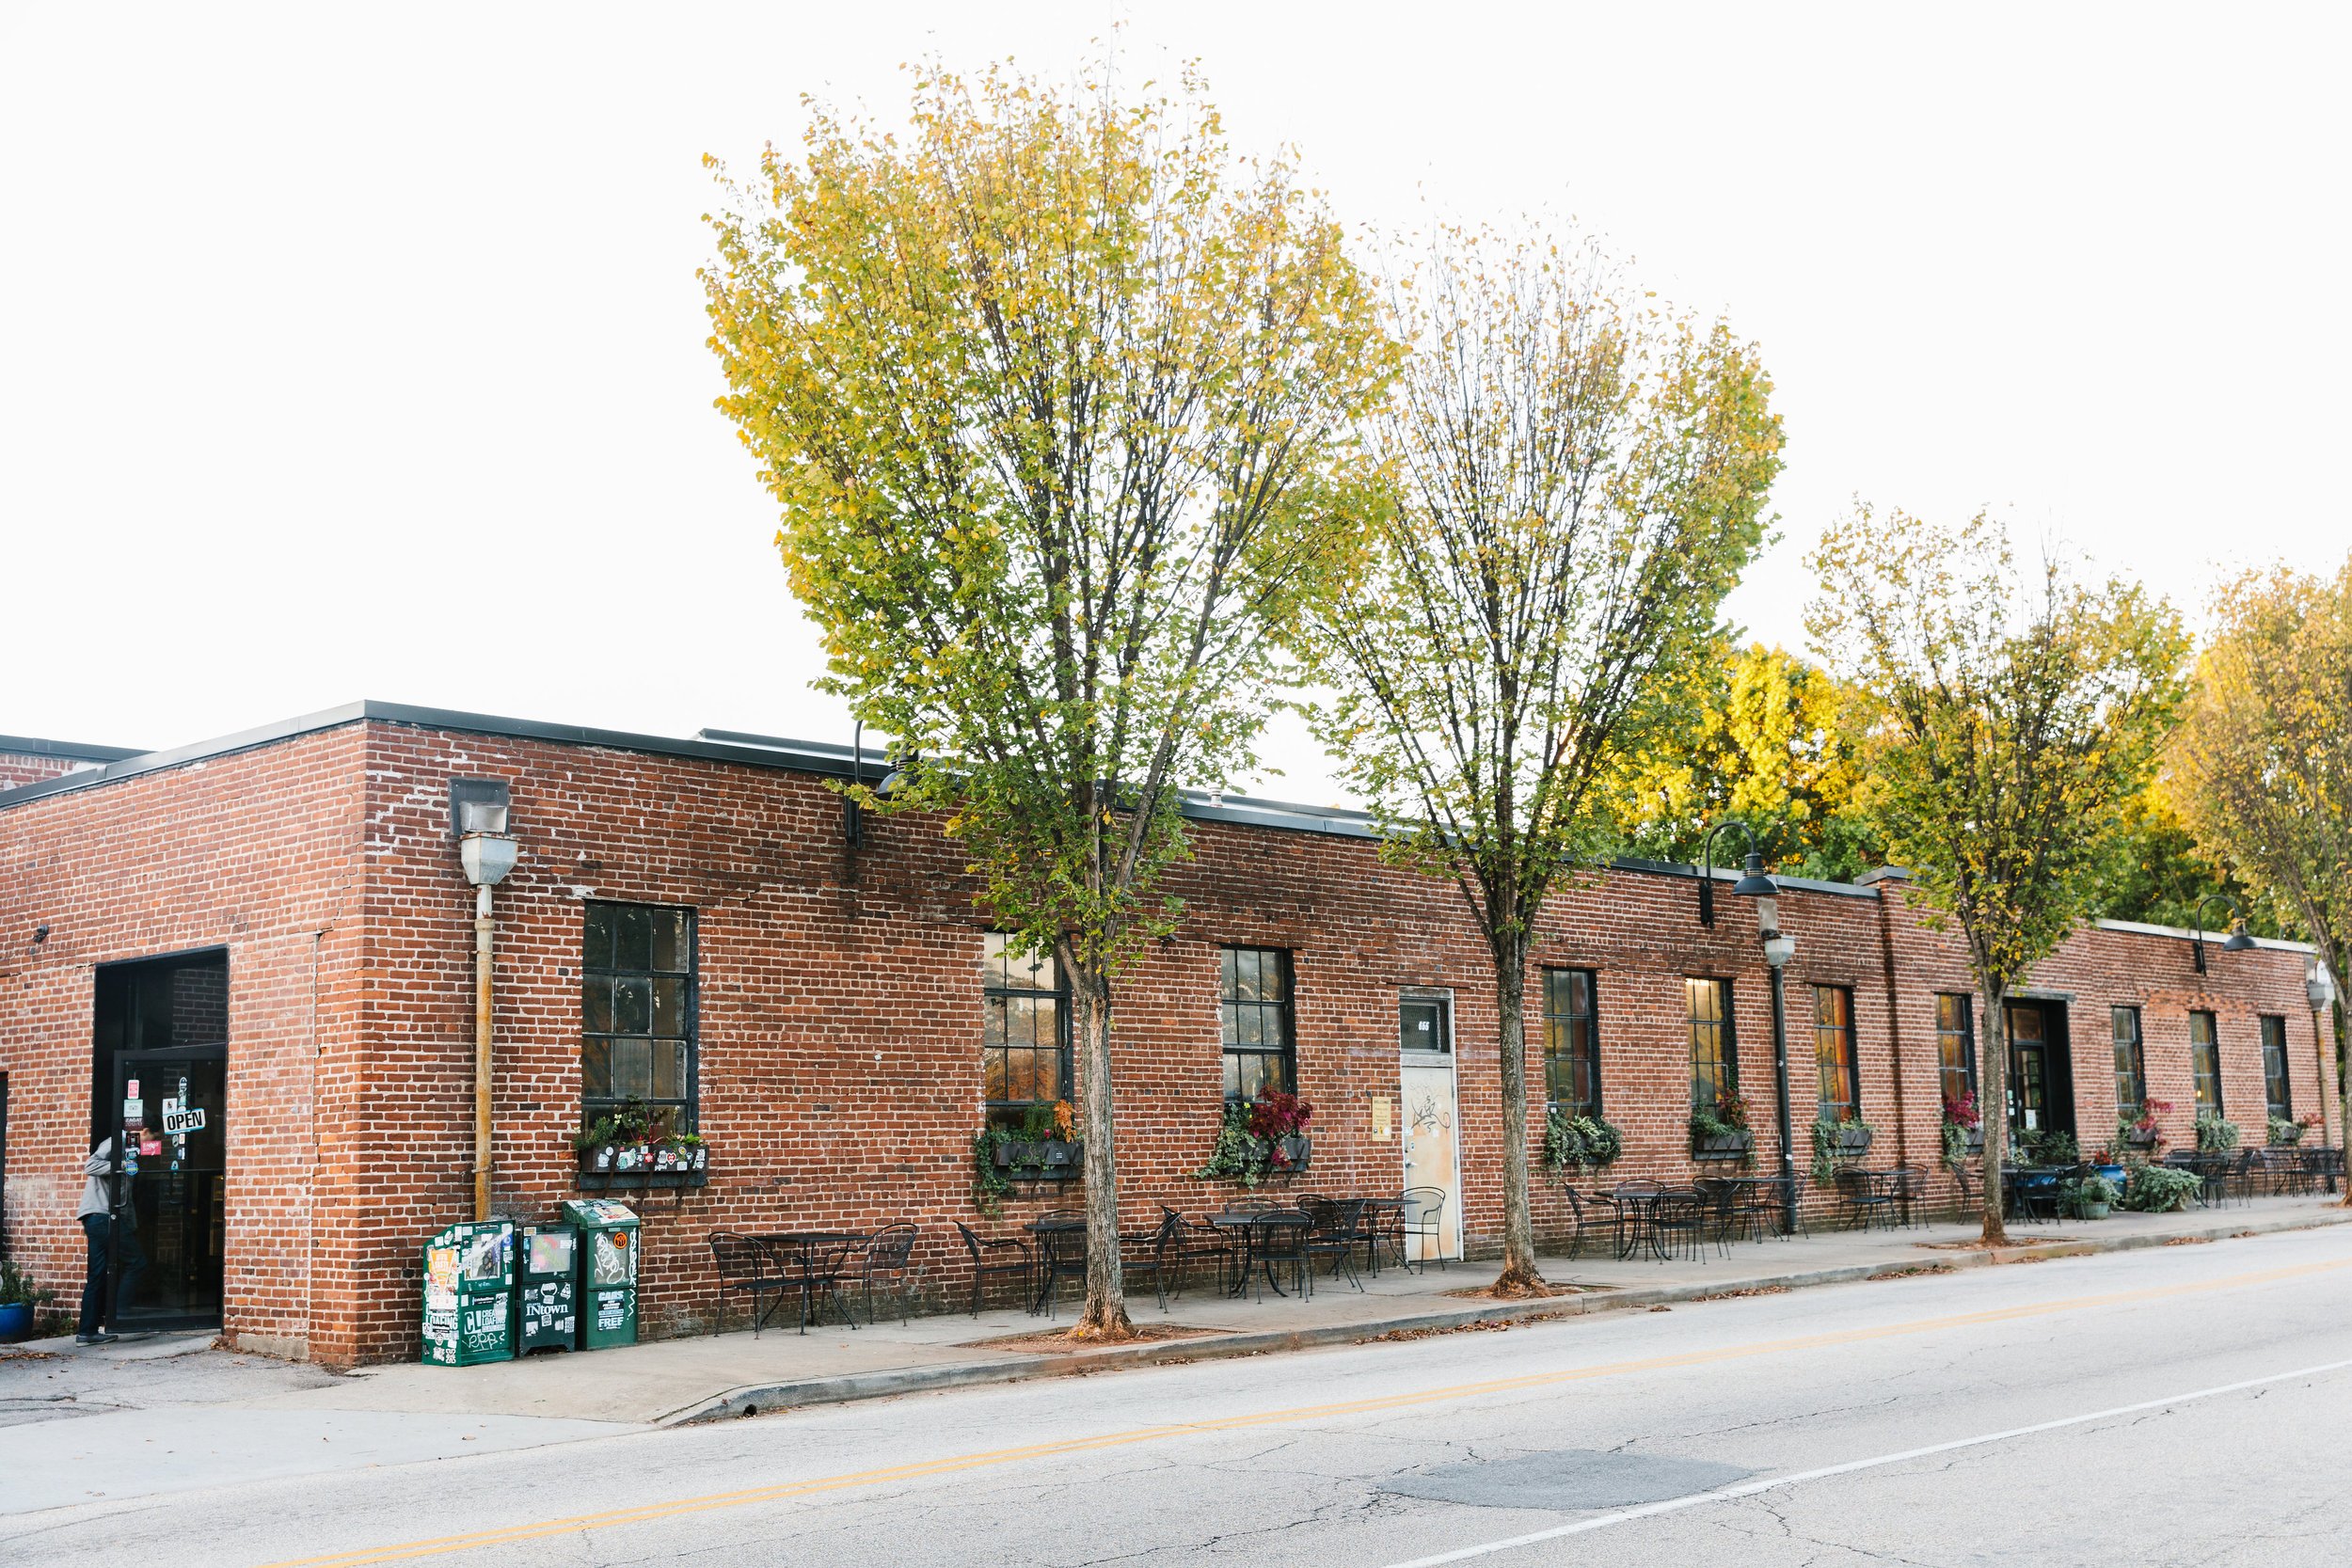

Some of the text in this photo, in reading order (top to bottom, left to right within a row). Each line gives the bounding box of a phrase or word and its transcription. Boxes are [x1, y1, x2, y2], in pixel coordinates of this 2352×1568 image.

[167, 1111, 202, 1131] OPEN
[526, 1304, 569, 1316] INtown
[598, 1317, 624, 1327] FREE
